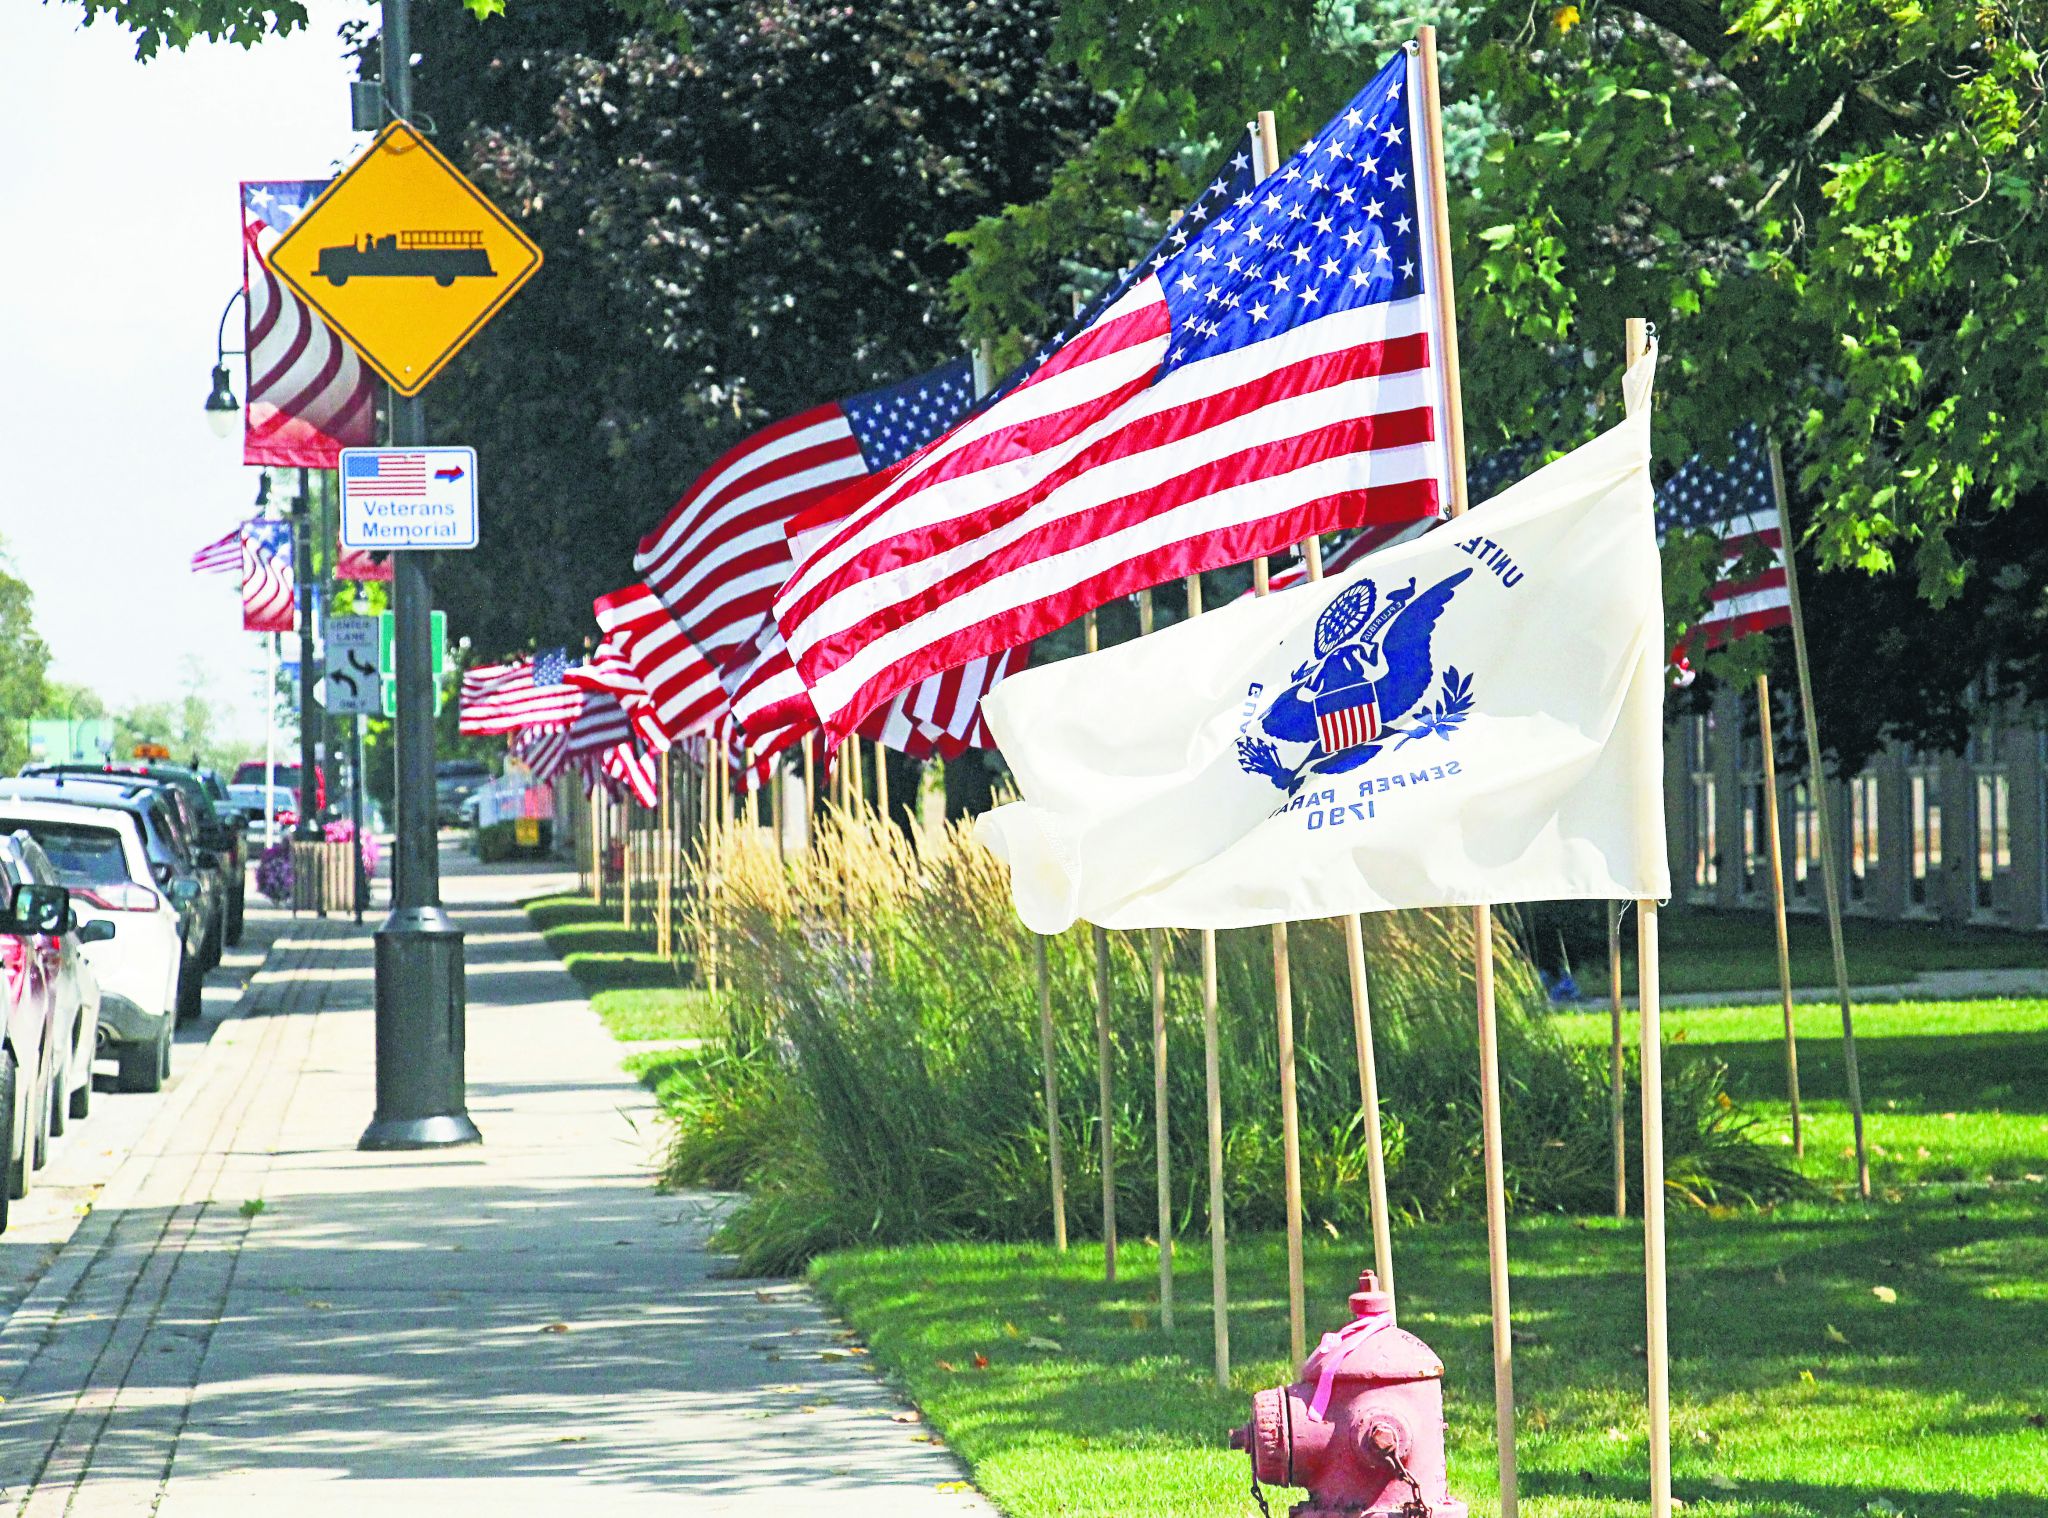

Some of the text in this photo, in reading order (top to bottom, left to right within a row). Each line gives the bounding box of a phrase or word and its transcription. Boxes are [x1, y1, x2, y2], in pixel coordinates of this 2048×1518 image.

[363, 500, 455, 516] Veterans
[362, 521, 457, 537] Memorial
[335, 632, 365, 641] LANE
